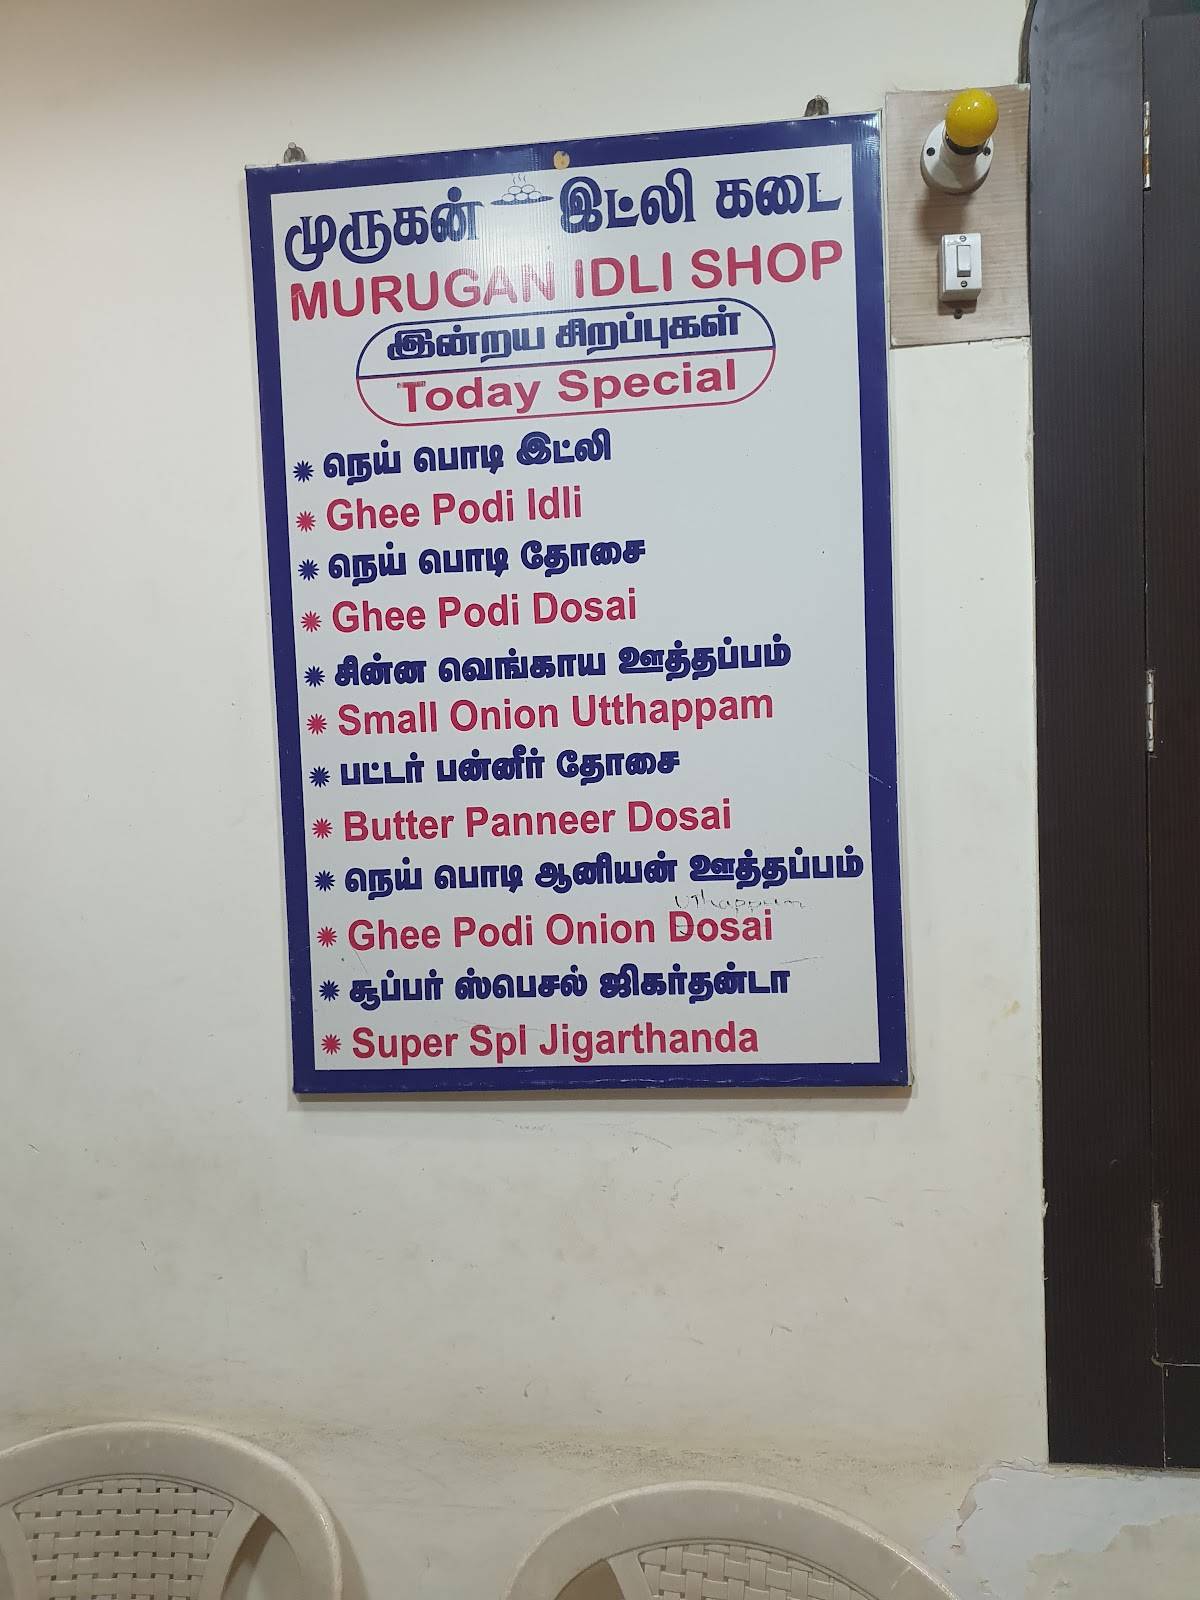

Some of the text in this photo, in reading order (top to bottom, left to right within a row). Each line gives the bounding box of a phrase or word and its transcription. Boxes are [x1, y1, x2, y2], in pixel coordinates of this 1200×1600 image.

[285, 167, 842, 271] முருகன் இட்லி கடை
[291, 240, 842, 320] MURUGAN IDLI SHOP
[555, 304, 742, 356] சிறப்புகள்
[397, 358, 736, 414] Today Special
[324, 428, 612, 485] நெய் பொடி இட்லி
[326, 485, 582, 532] Ghee Podi Idli
[329, 539, 646, 586] நெய் பொடி தோசை
[331, 587, 636, 634] Ghee Podi Dosai
[334, 633, 792, 687] சின்ன வெங்காய ஊத்தப்பம்
[337, 693, 774, 737] Small Onion Utthappam
[340, 743, 681, 786] பட்டர் பன்னீர் தோசை
[343, 799, 731, 842] Butter Panneer Dosai
[345, 844, 864, 900] நெய் பொடி ஆனியன் ஊத்தப்பம்
[347, 909, 773, 952] Ghee Podi Onion Dosai
[349, 969, 444, 1012] சூப்பர்
[352, 1020, 759, 1066] Super Spl Jigarthanda
